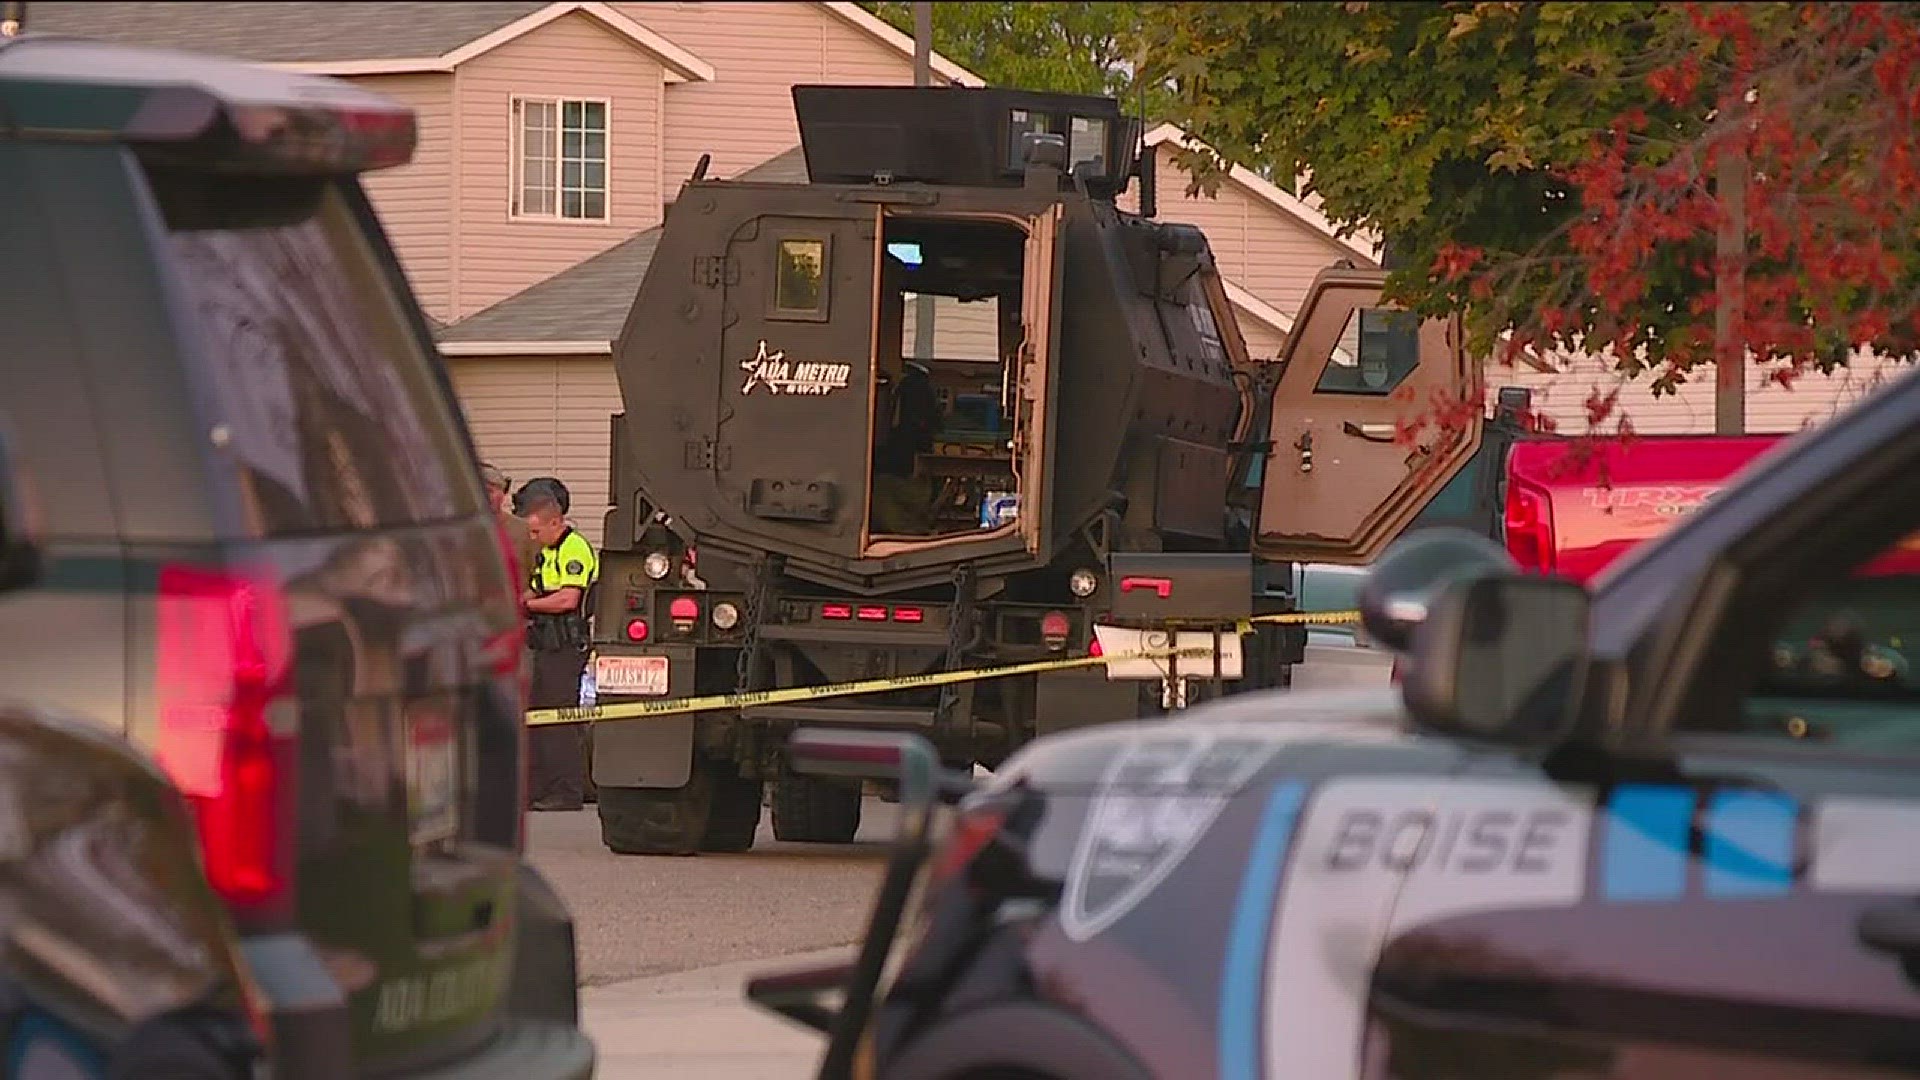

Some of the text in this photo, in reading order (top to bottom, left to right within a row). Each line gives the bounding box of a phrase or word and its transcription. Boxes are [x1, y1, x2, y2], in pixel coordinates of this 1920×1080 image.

[753, 361, 850, 382] ADA METRO
[1323, 808, 1572, 874] BOISE
